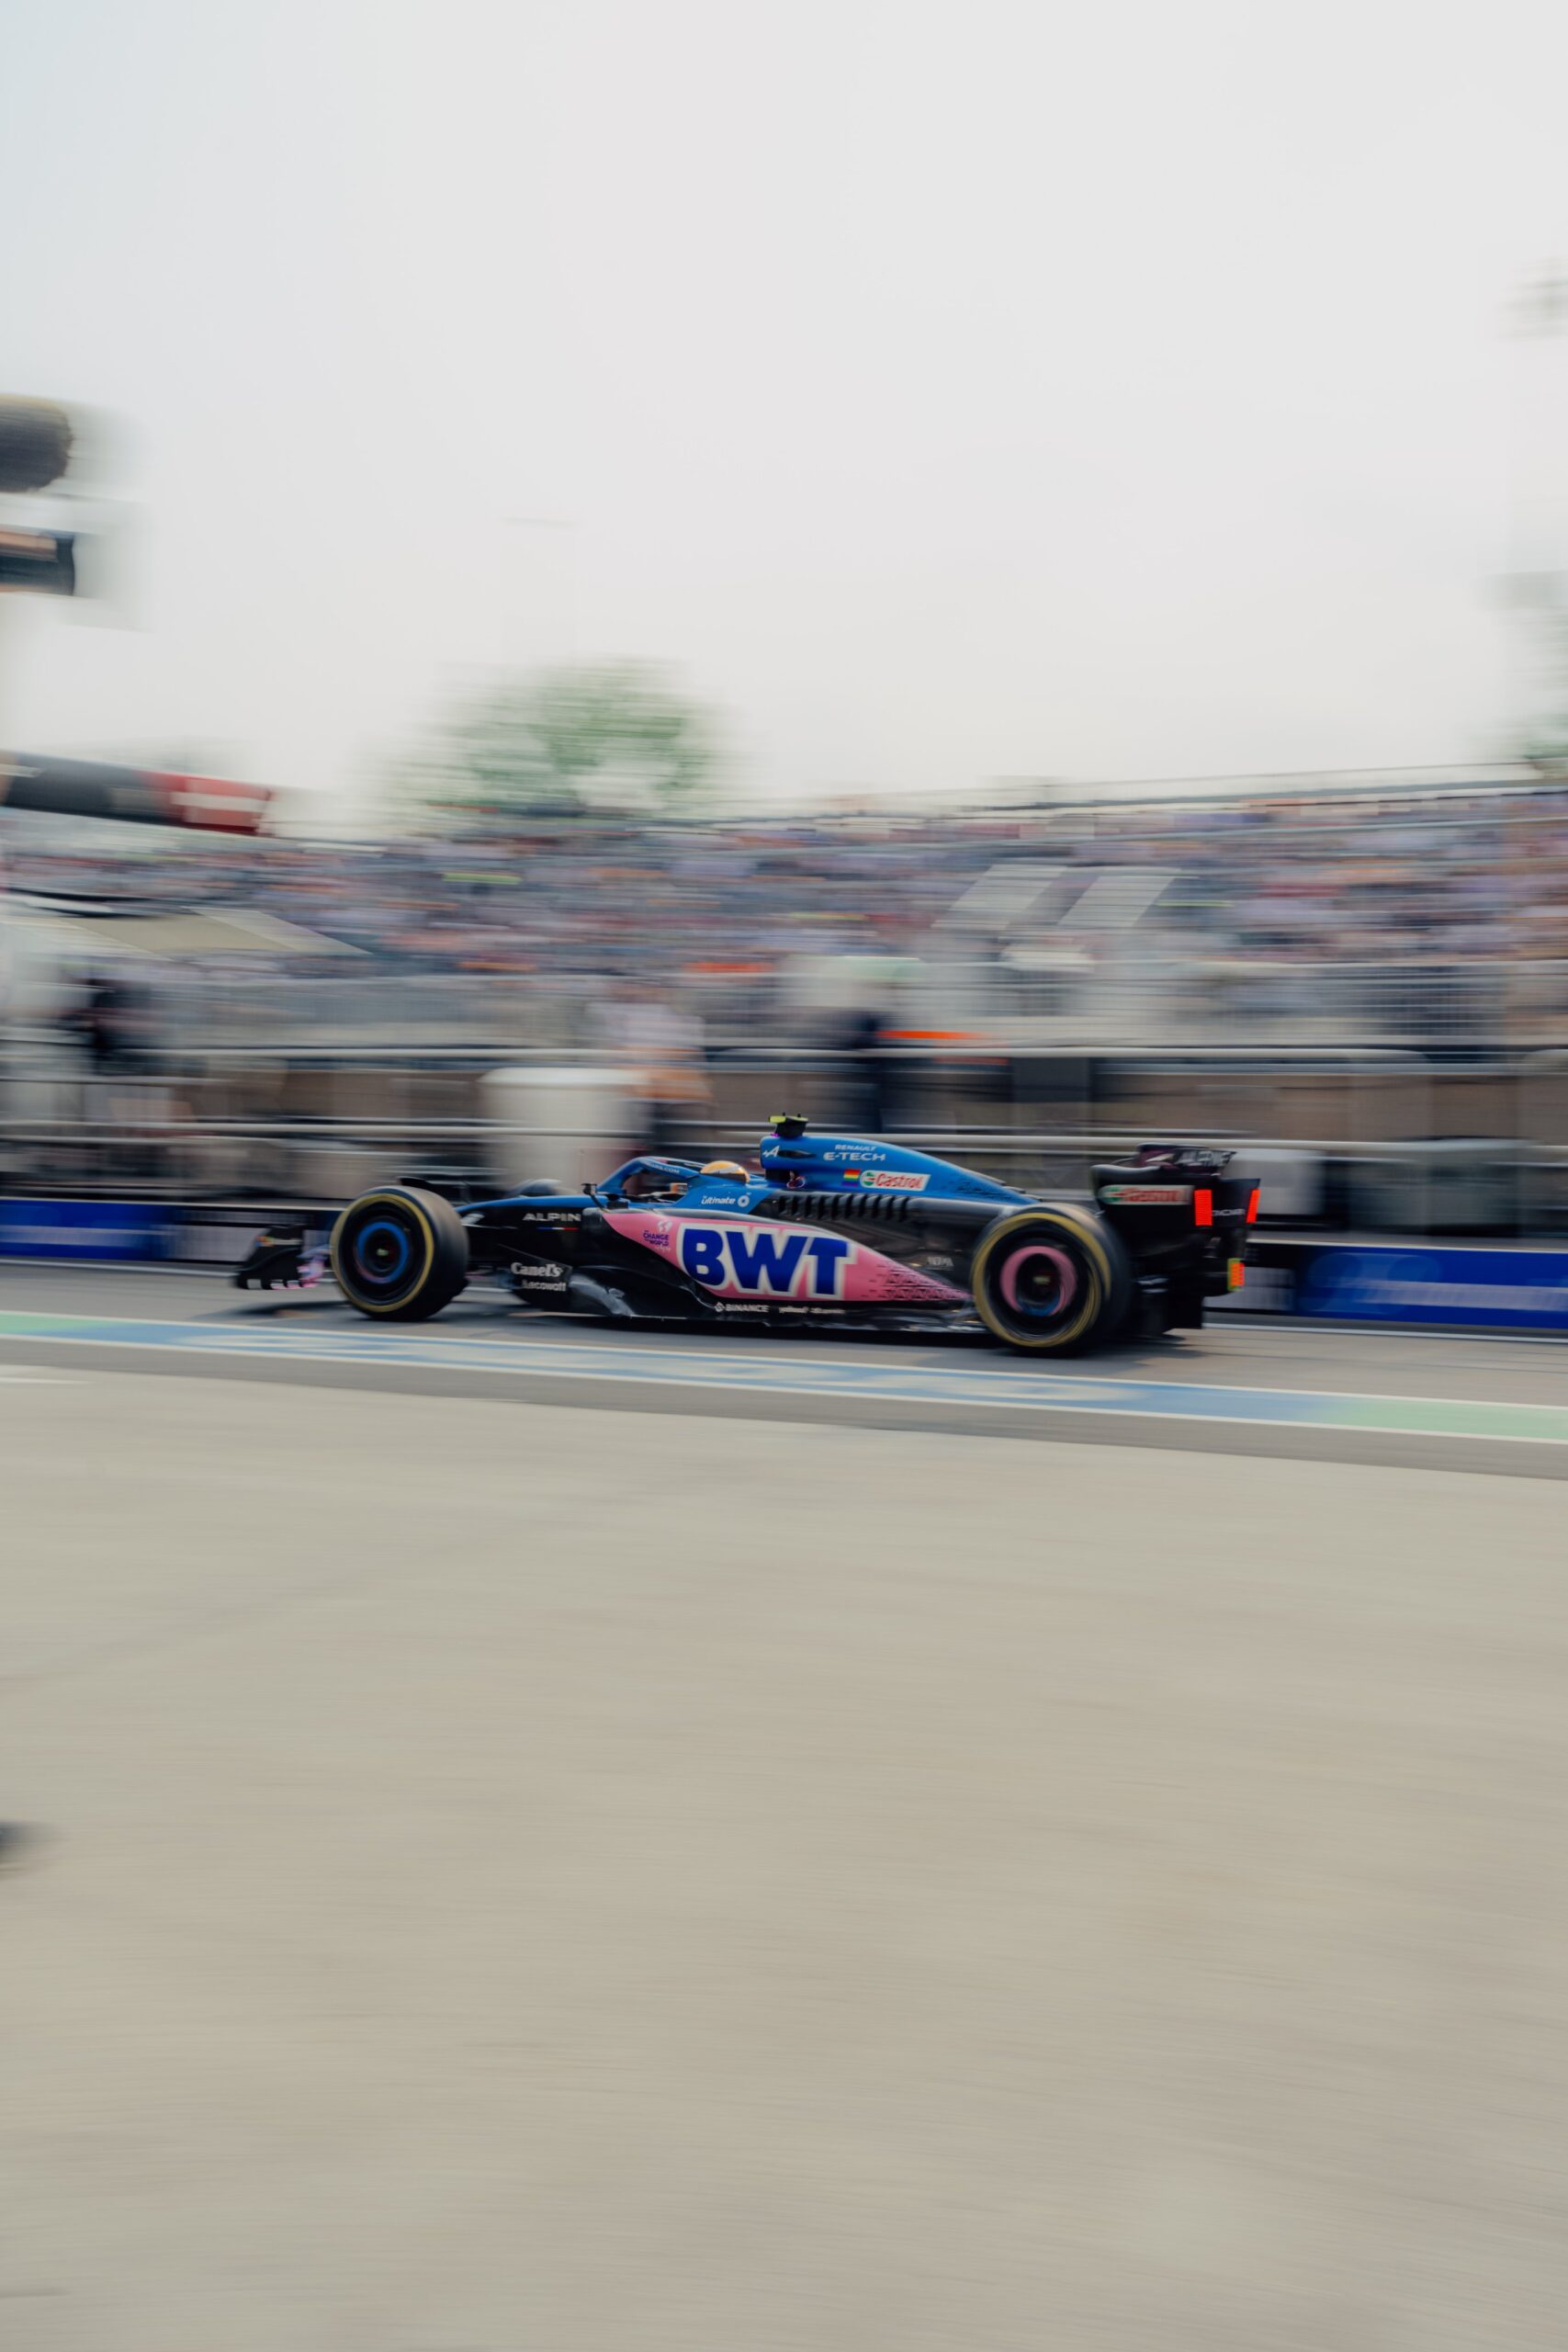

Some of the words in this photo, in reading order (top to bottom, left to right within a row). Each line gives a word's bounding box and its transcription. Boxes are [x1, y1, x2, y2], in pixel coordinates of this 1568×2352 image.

[823, 1152, 886, 1161] E-TECH
[875, 1173, 922, 1190] Castrol
[523, 1213, 581, 1221] ALPIN
[682, 1228, 848, 1295] BWT
[511, 1261, 563, 1277] Canel's
[725, 1305, 770, 1313] BINANCE
